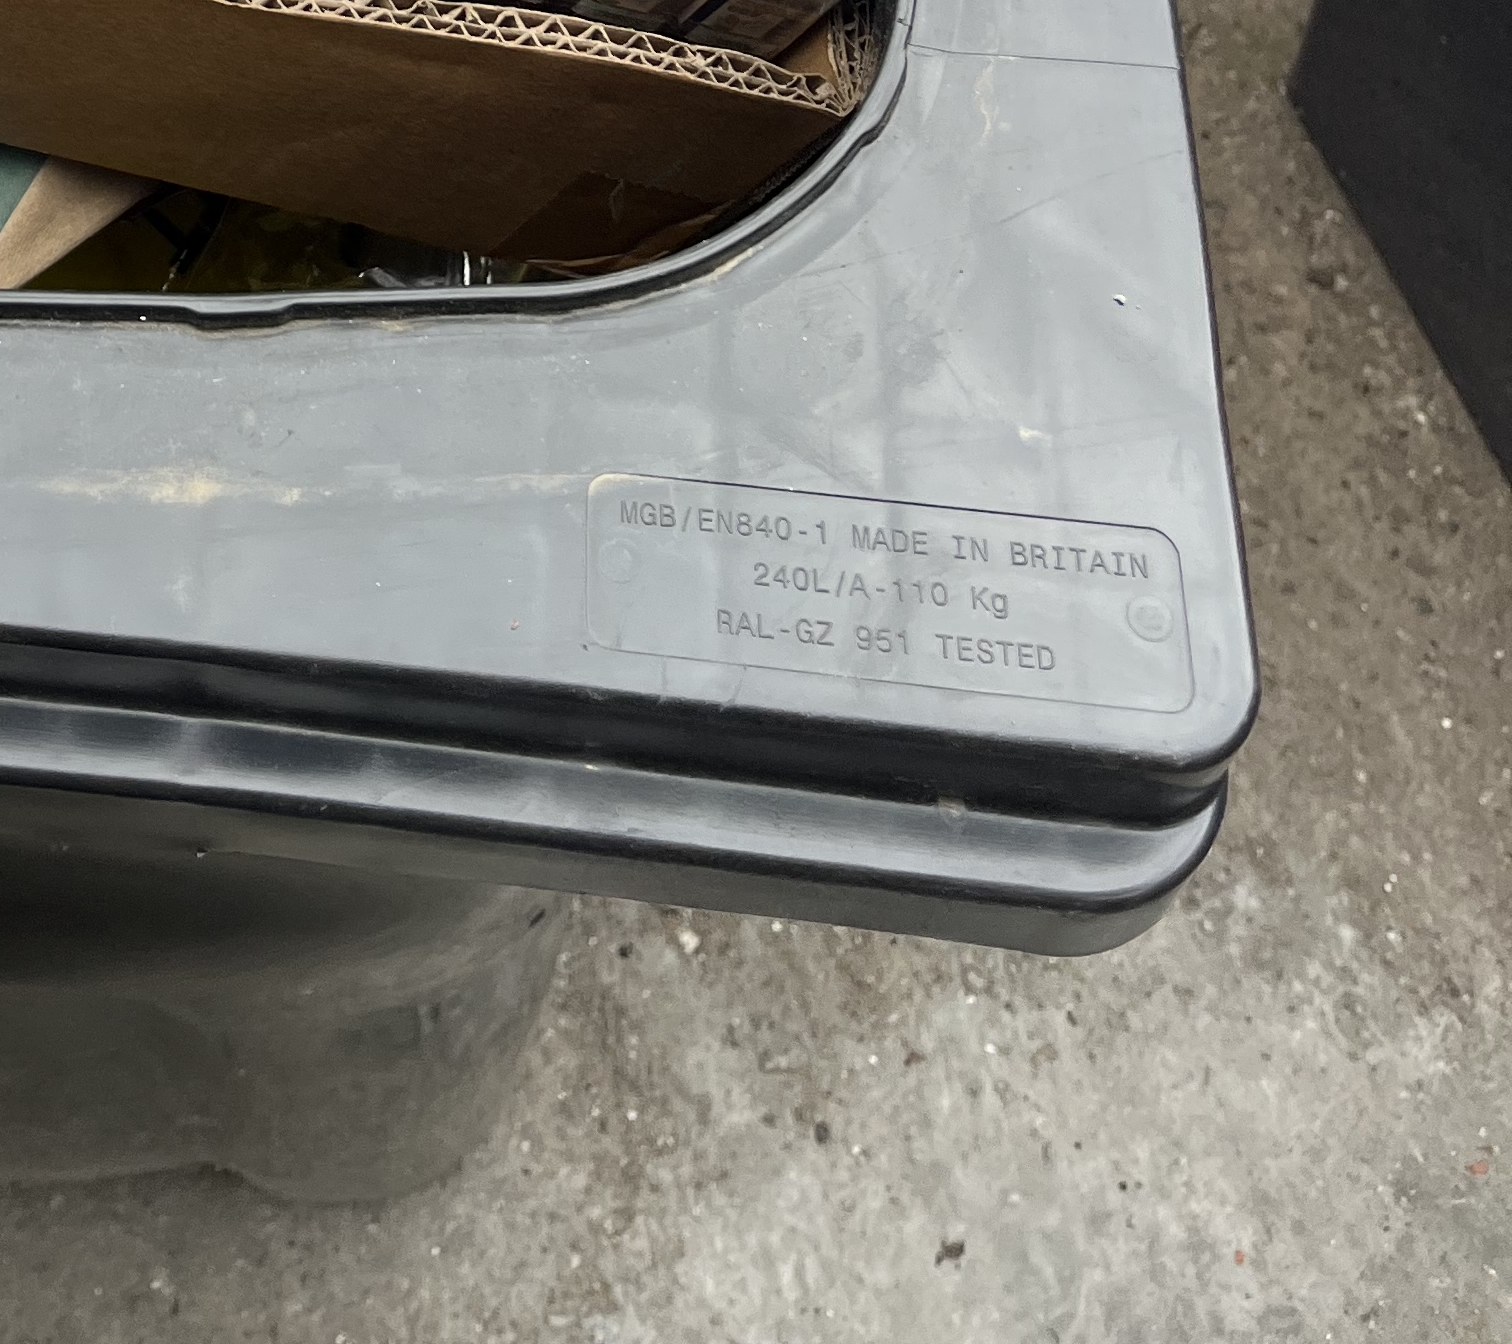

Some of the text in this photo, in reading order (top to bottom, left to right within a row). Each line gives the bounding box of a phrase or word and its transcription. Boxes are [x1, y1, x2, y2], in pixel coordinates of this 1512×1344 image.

[619, 499, 1149, 580] MGB/EN840-1 MADE IN BRITAIN
[753, 561, 1009, 621] 240L/A-110 Kg
[717, 610, 1056, 673] RAL-GZ 951 TESTED
